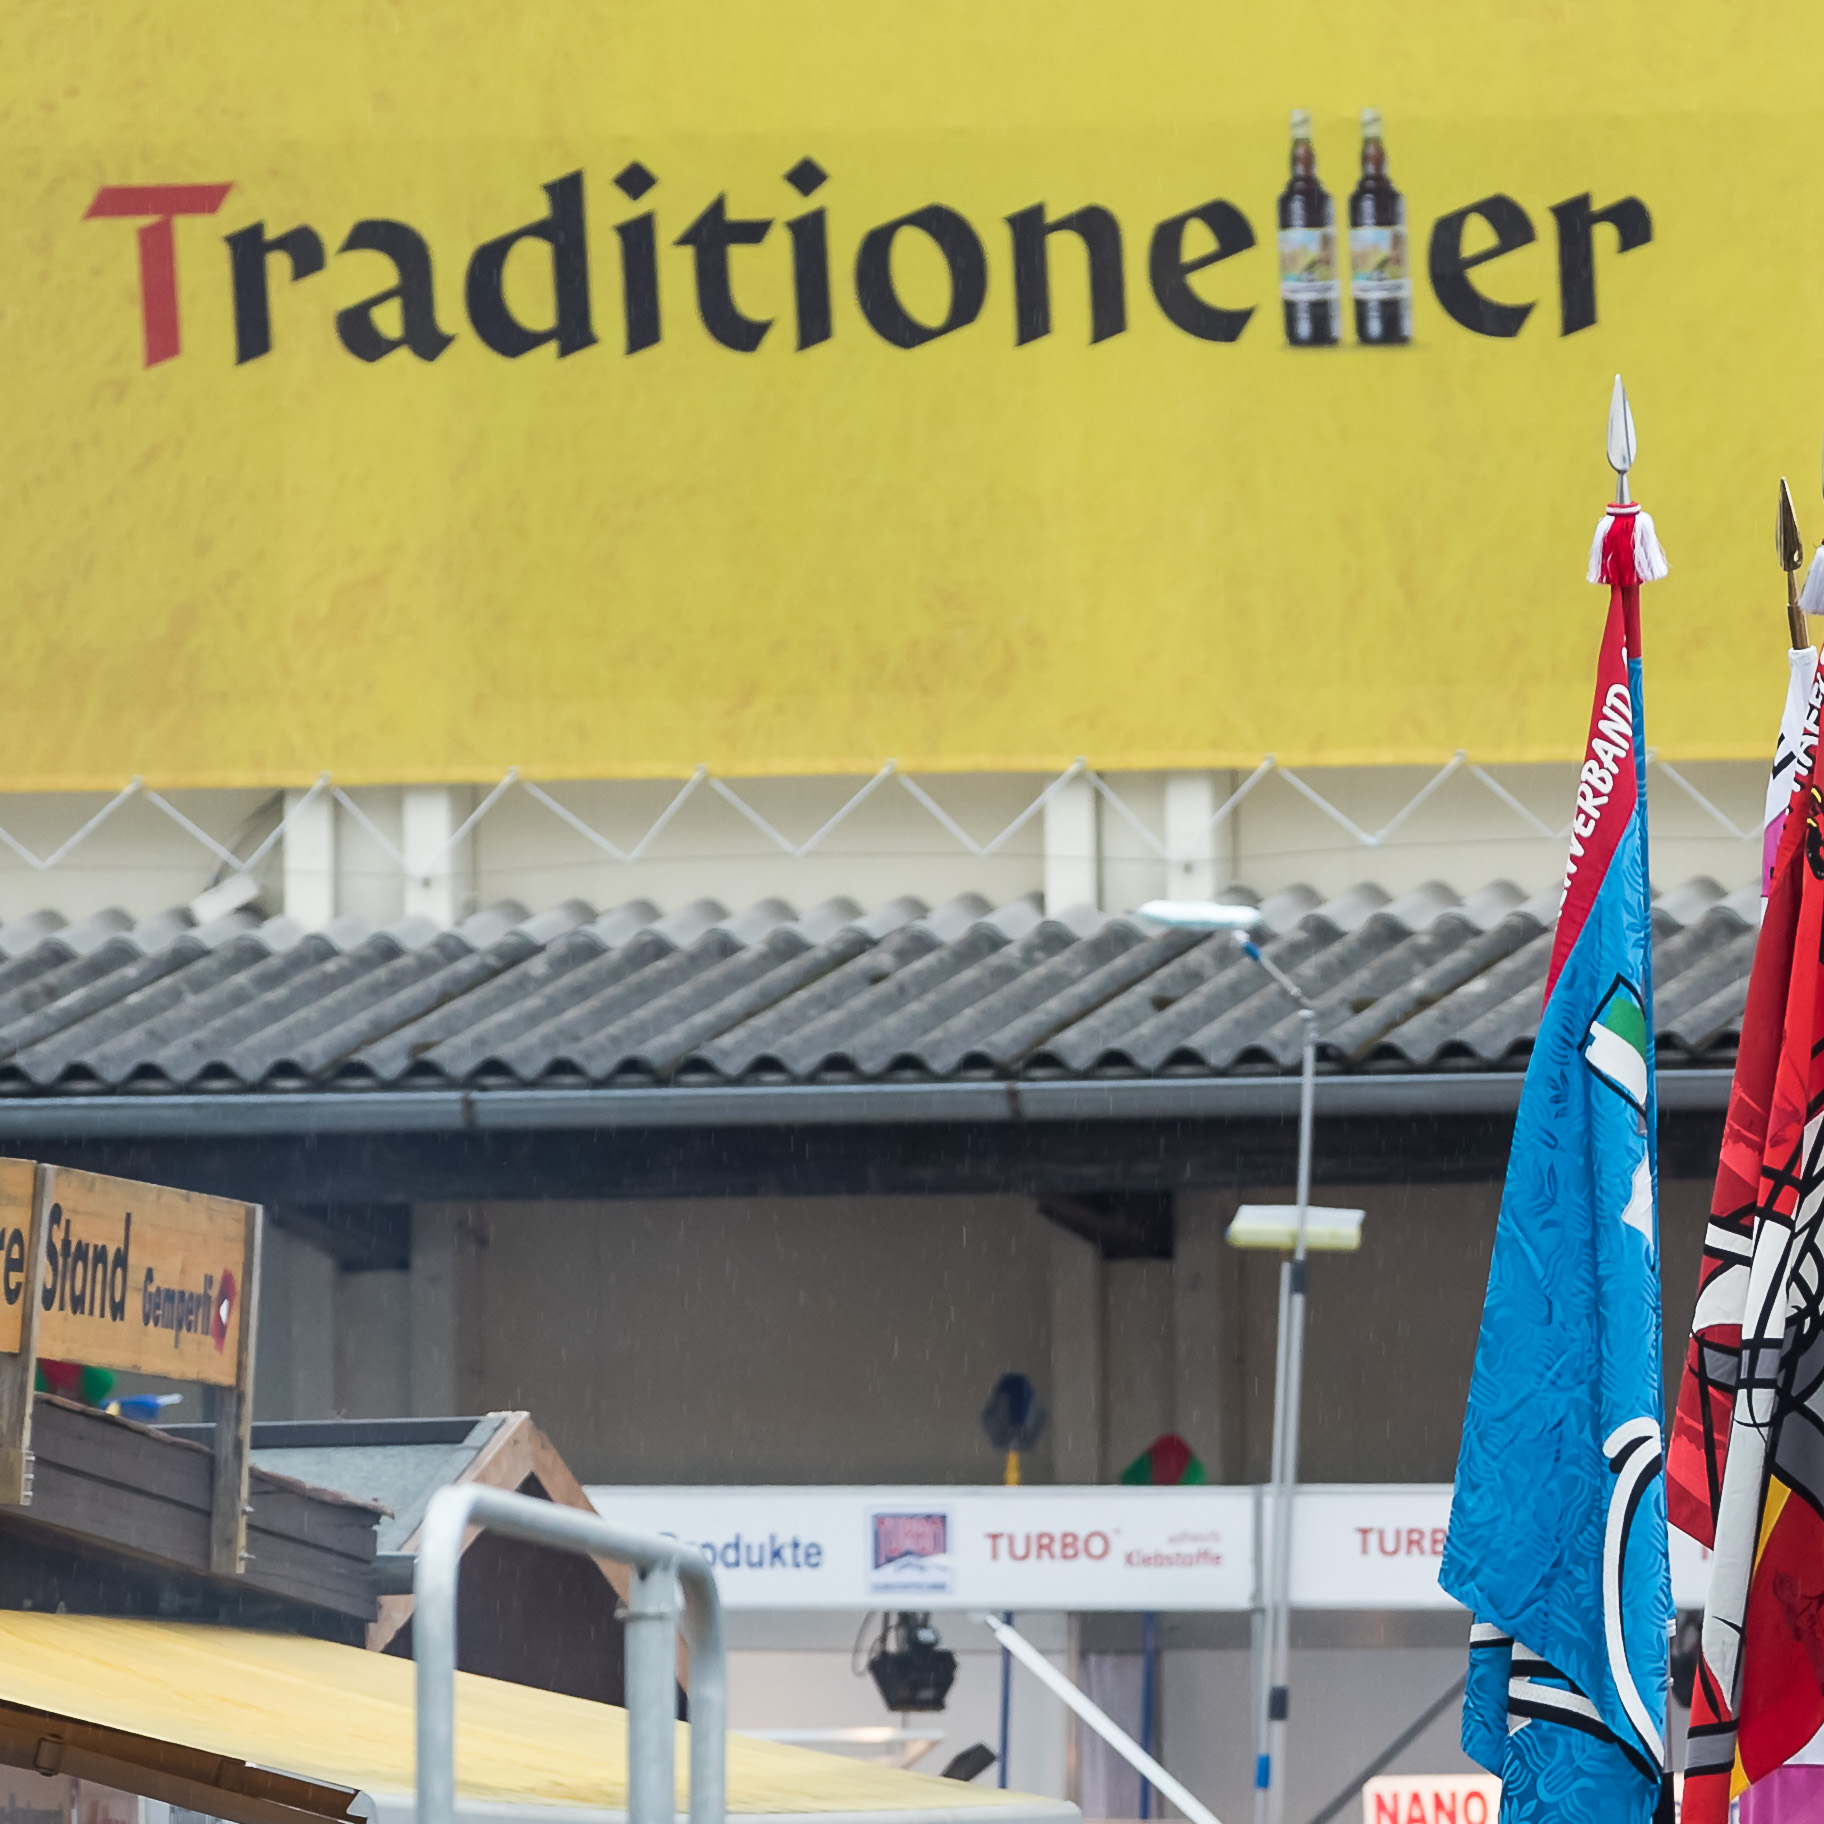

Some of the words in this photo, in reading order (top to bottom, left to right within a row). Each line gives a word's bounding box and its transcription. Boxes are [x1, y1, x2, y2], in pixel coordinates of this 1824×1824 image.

[41, 1202, 132, 1322] Stand
[142, 1266, 214, 1349] Gemperli
[985, 1530, 1111, 1561] TURBO
[1355, 1526, 1447, 1557] TURB
